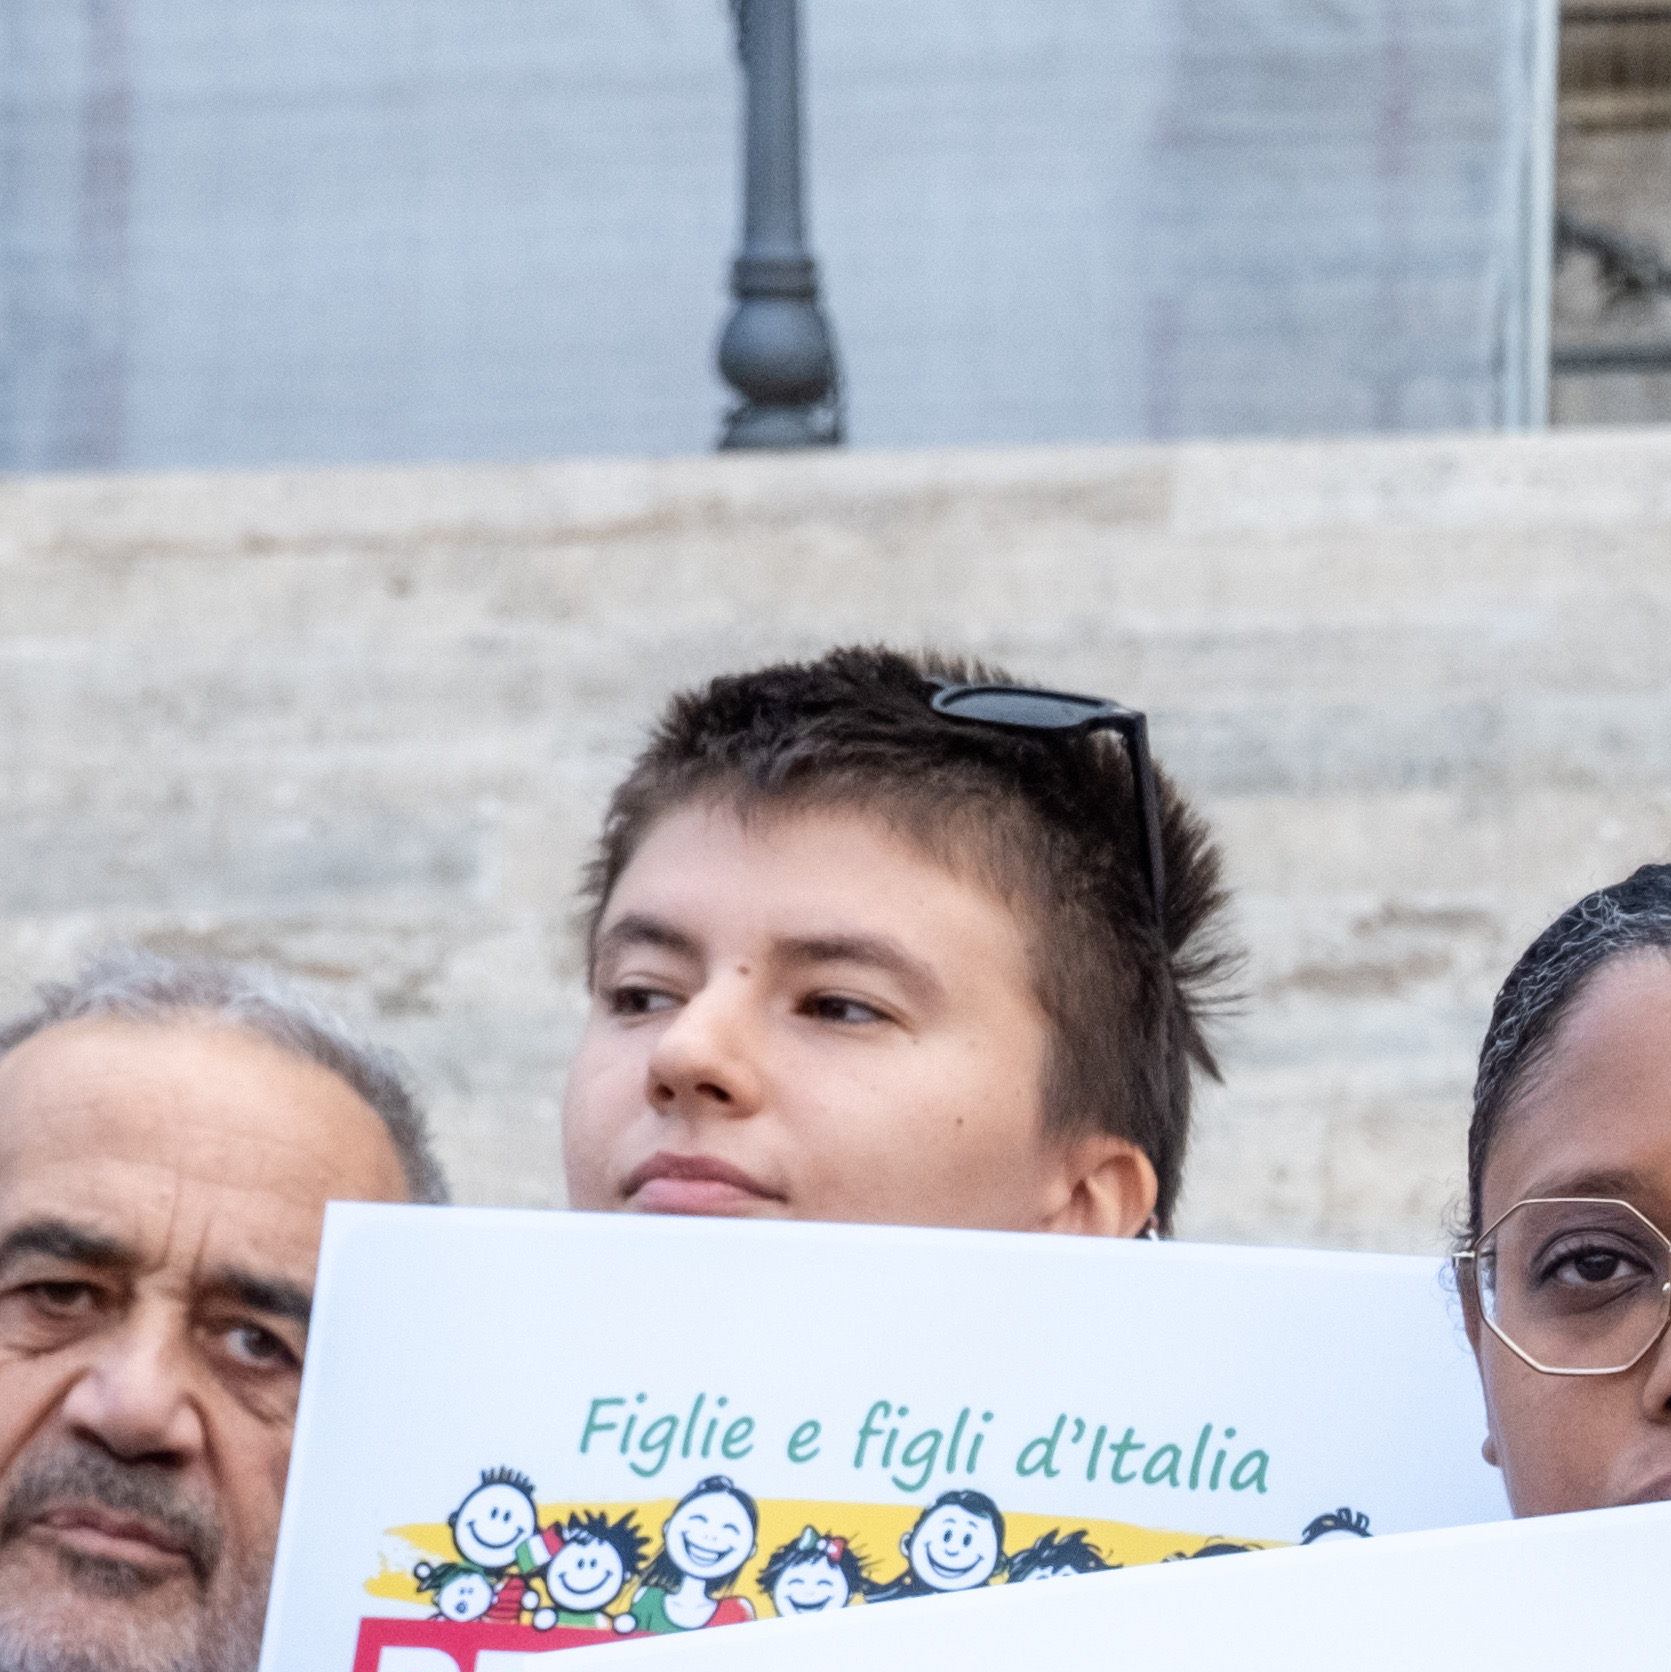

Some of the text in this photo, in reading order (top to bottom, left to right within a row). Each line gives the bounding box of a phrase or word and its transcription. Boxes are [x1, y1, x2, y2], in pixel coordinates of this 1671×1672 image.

[579, 1393, 1270, 1493] Figlie e figli d'Italia
